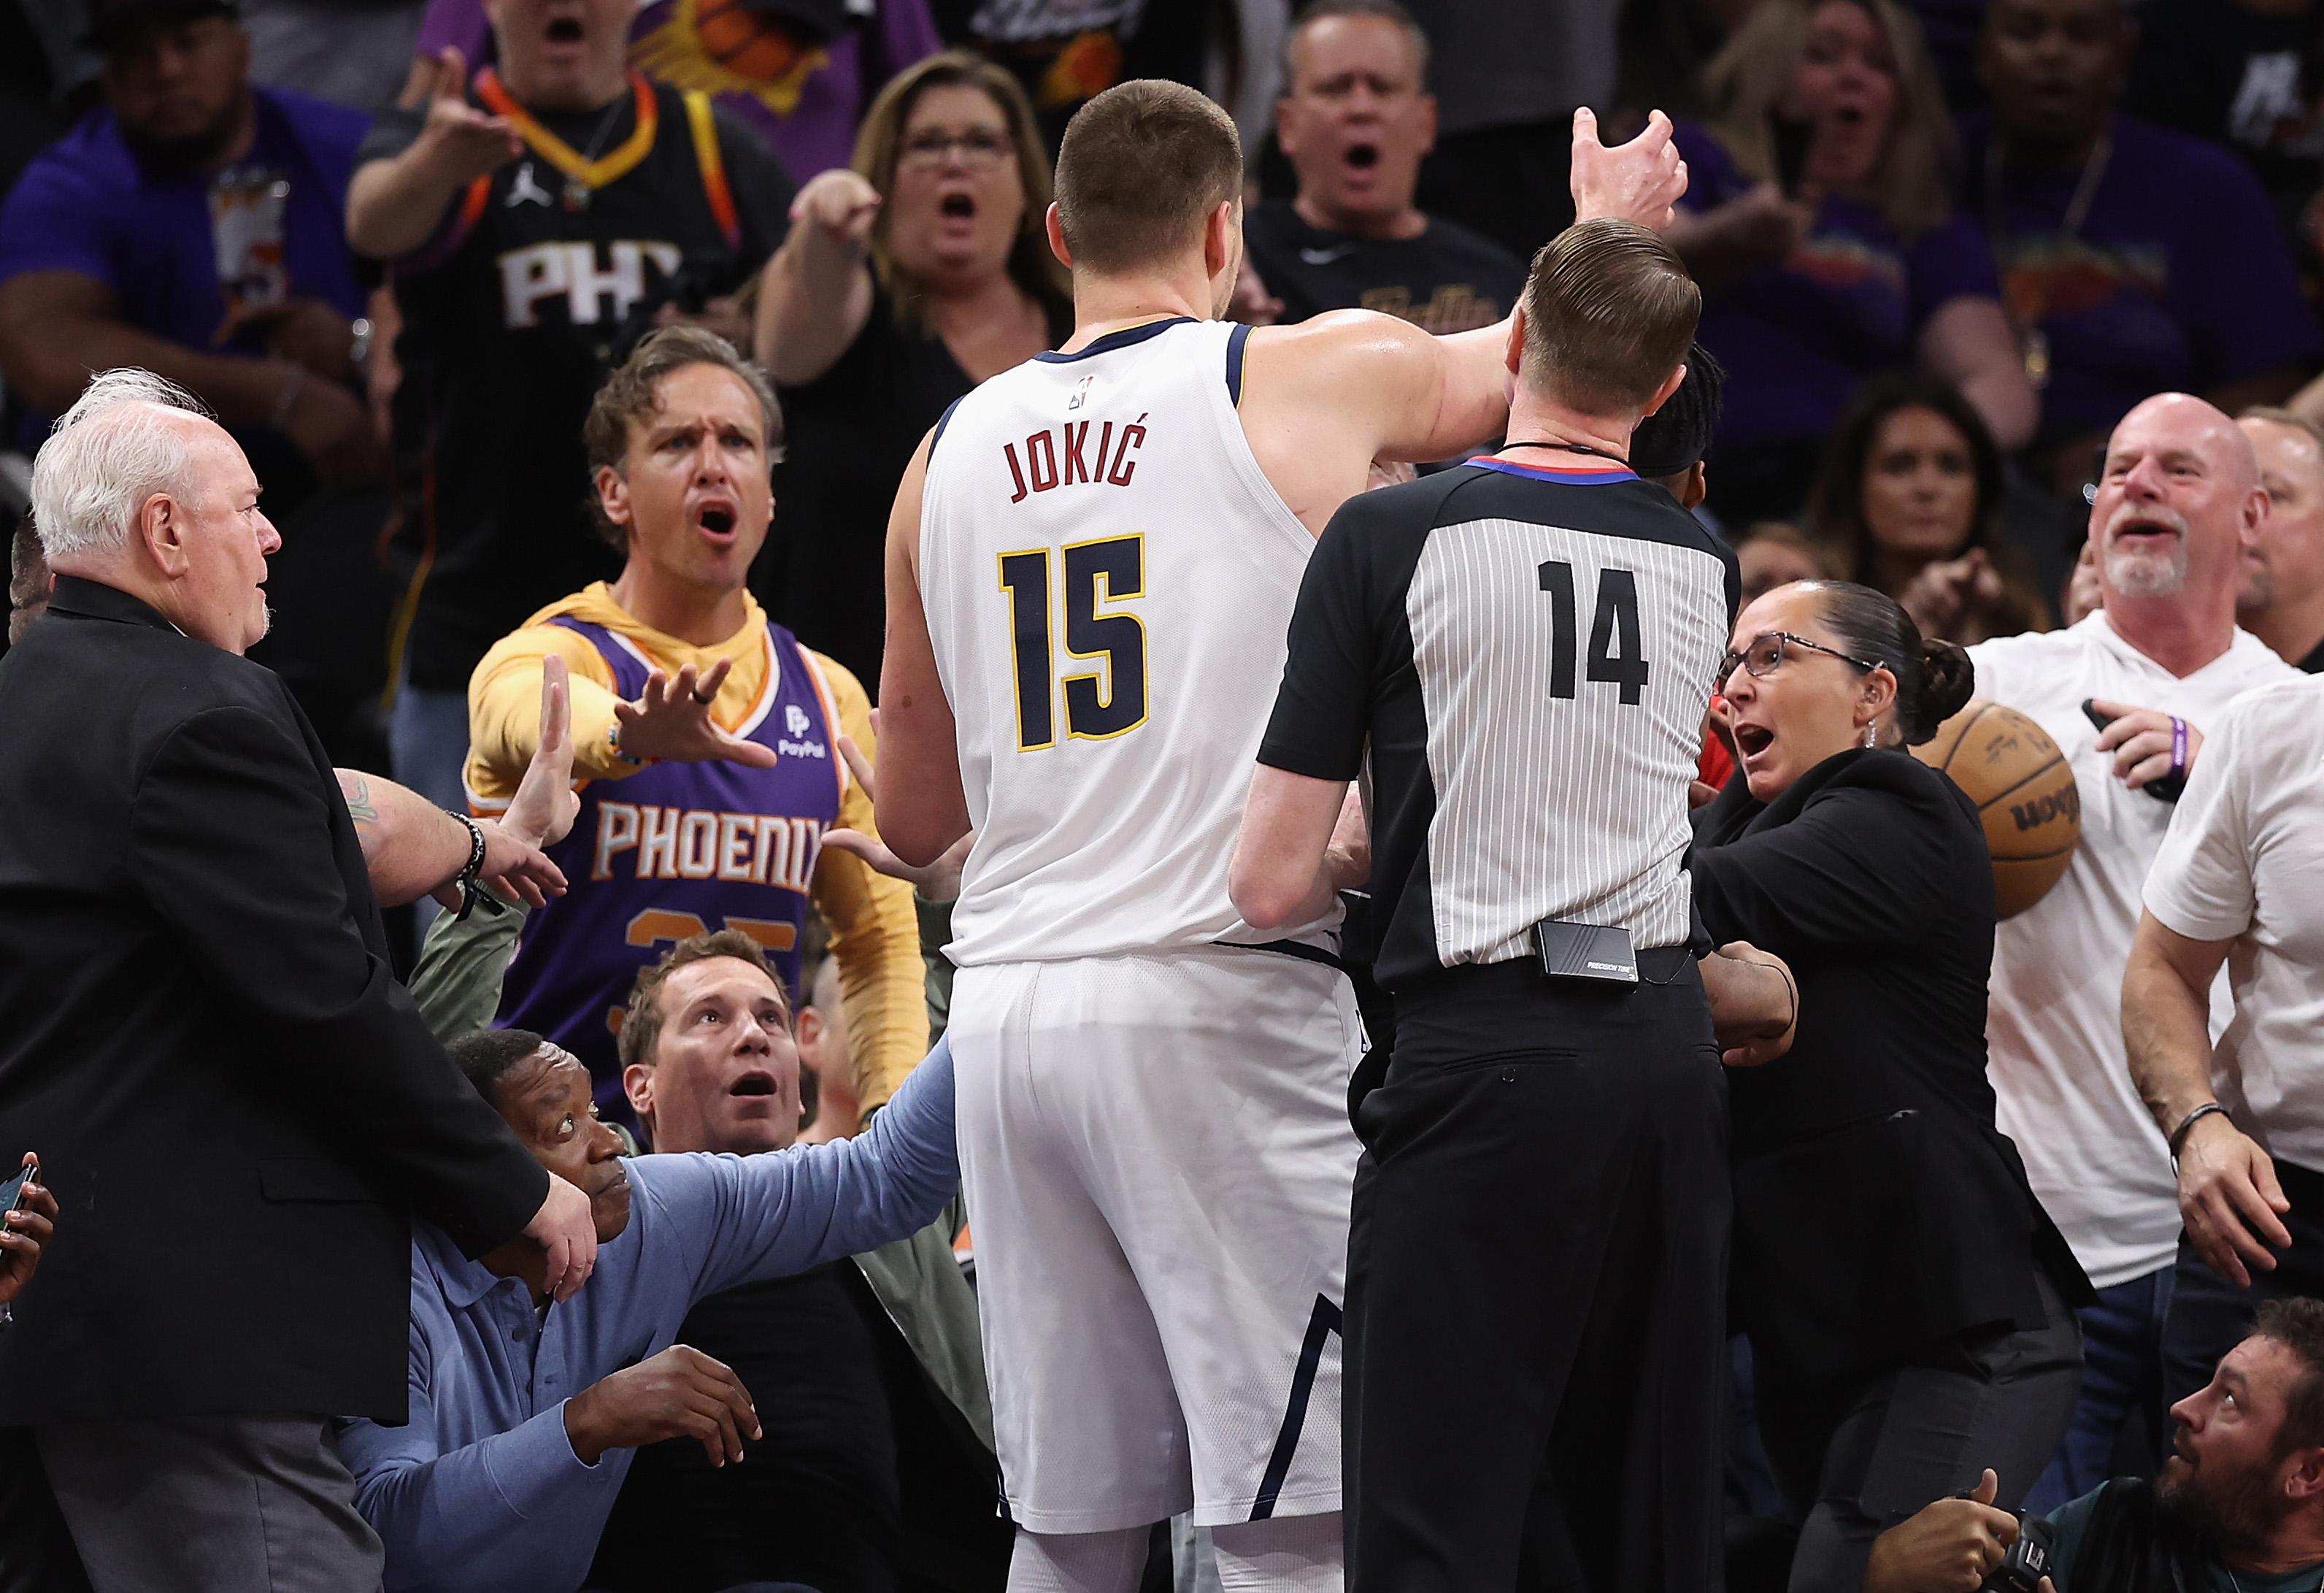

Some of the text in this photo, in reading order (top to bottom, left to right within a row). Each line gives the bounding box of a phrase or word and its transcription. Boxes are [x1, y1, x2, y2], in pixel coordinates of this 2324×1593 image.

[1003, 412, 1149, 504] JOKIĆ
[997, 531, 1150, 753] 15
[1538, 561, 1649, 706] 14
[778, 739, 826, 759] PayPal
